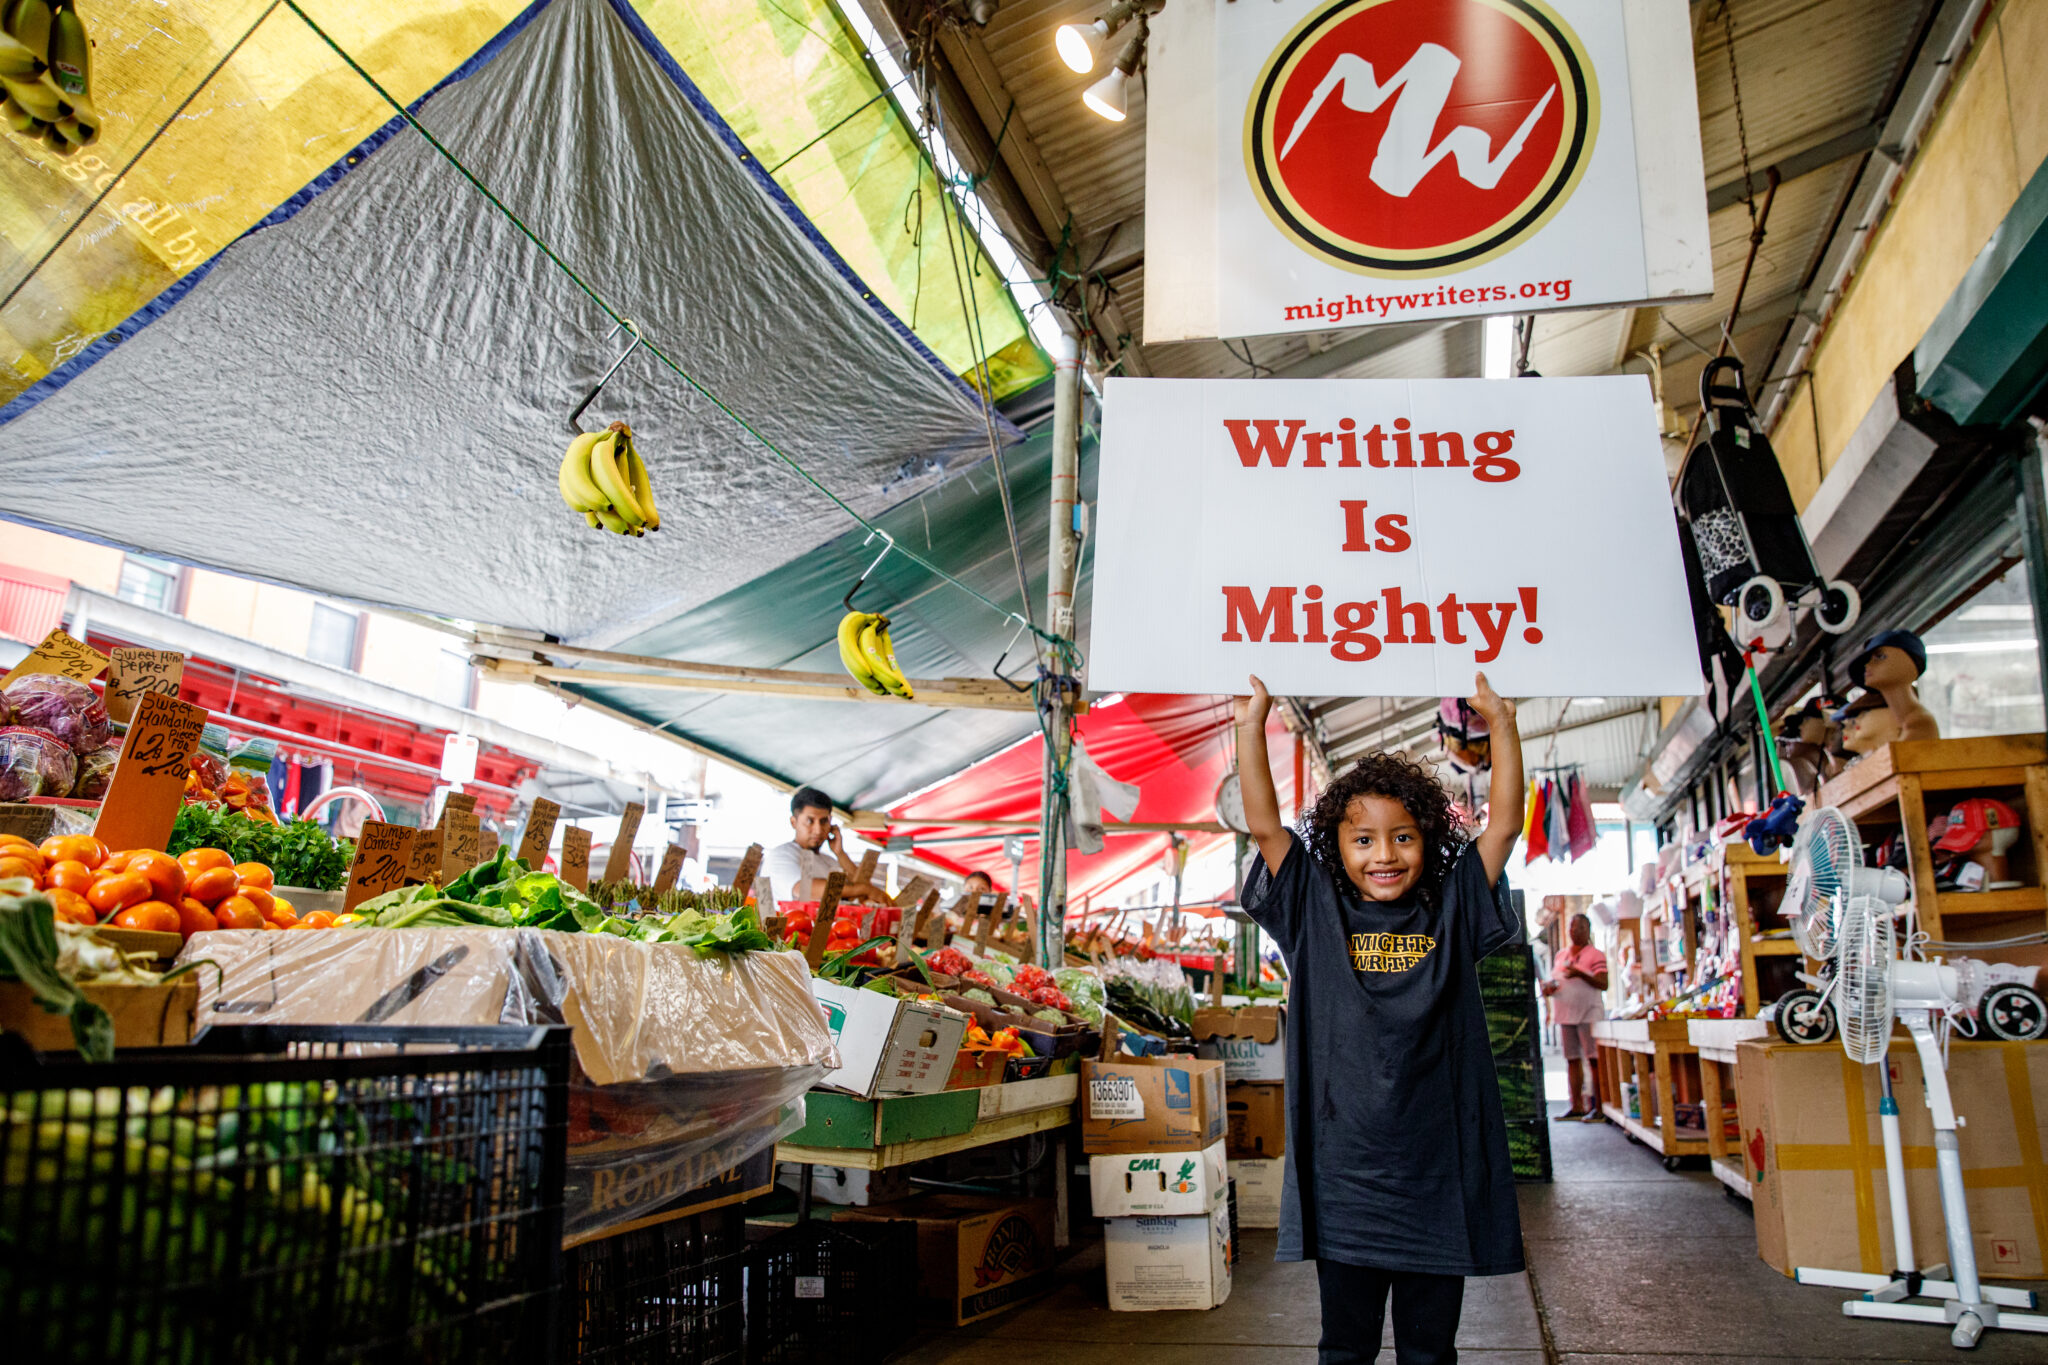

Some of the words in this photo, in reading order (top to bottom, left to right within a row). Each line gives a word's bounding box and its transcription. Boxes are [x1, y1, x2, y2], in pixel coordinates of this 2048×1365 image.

[121, 196, 182, 236] all
[1284, 278, 1573, 323] mightywriters.org
[1223, 417, 1521, 483] Writing
[1340, 500, 1412, 553] Is
[1221, 584, 1544, 663] Mighty!
[365, 822, 412, 840] Jumbo
[1215, 1041, 1265, 1059] MAGIC
[1091, 1081, 1135, 1101] 13663901
[590, 1145, 746, 1214] ROMAINE
[1135, 1216, 1178, 1228] Sunkist
